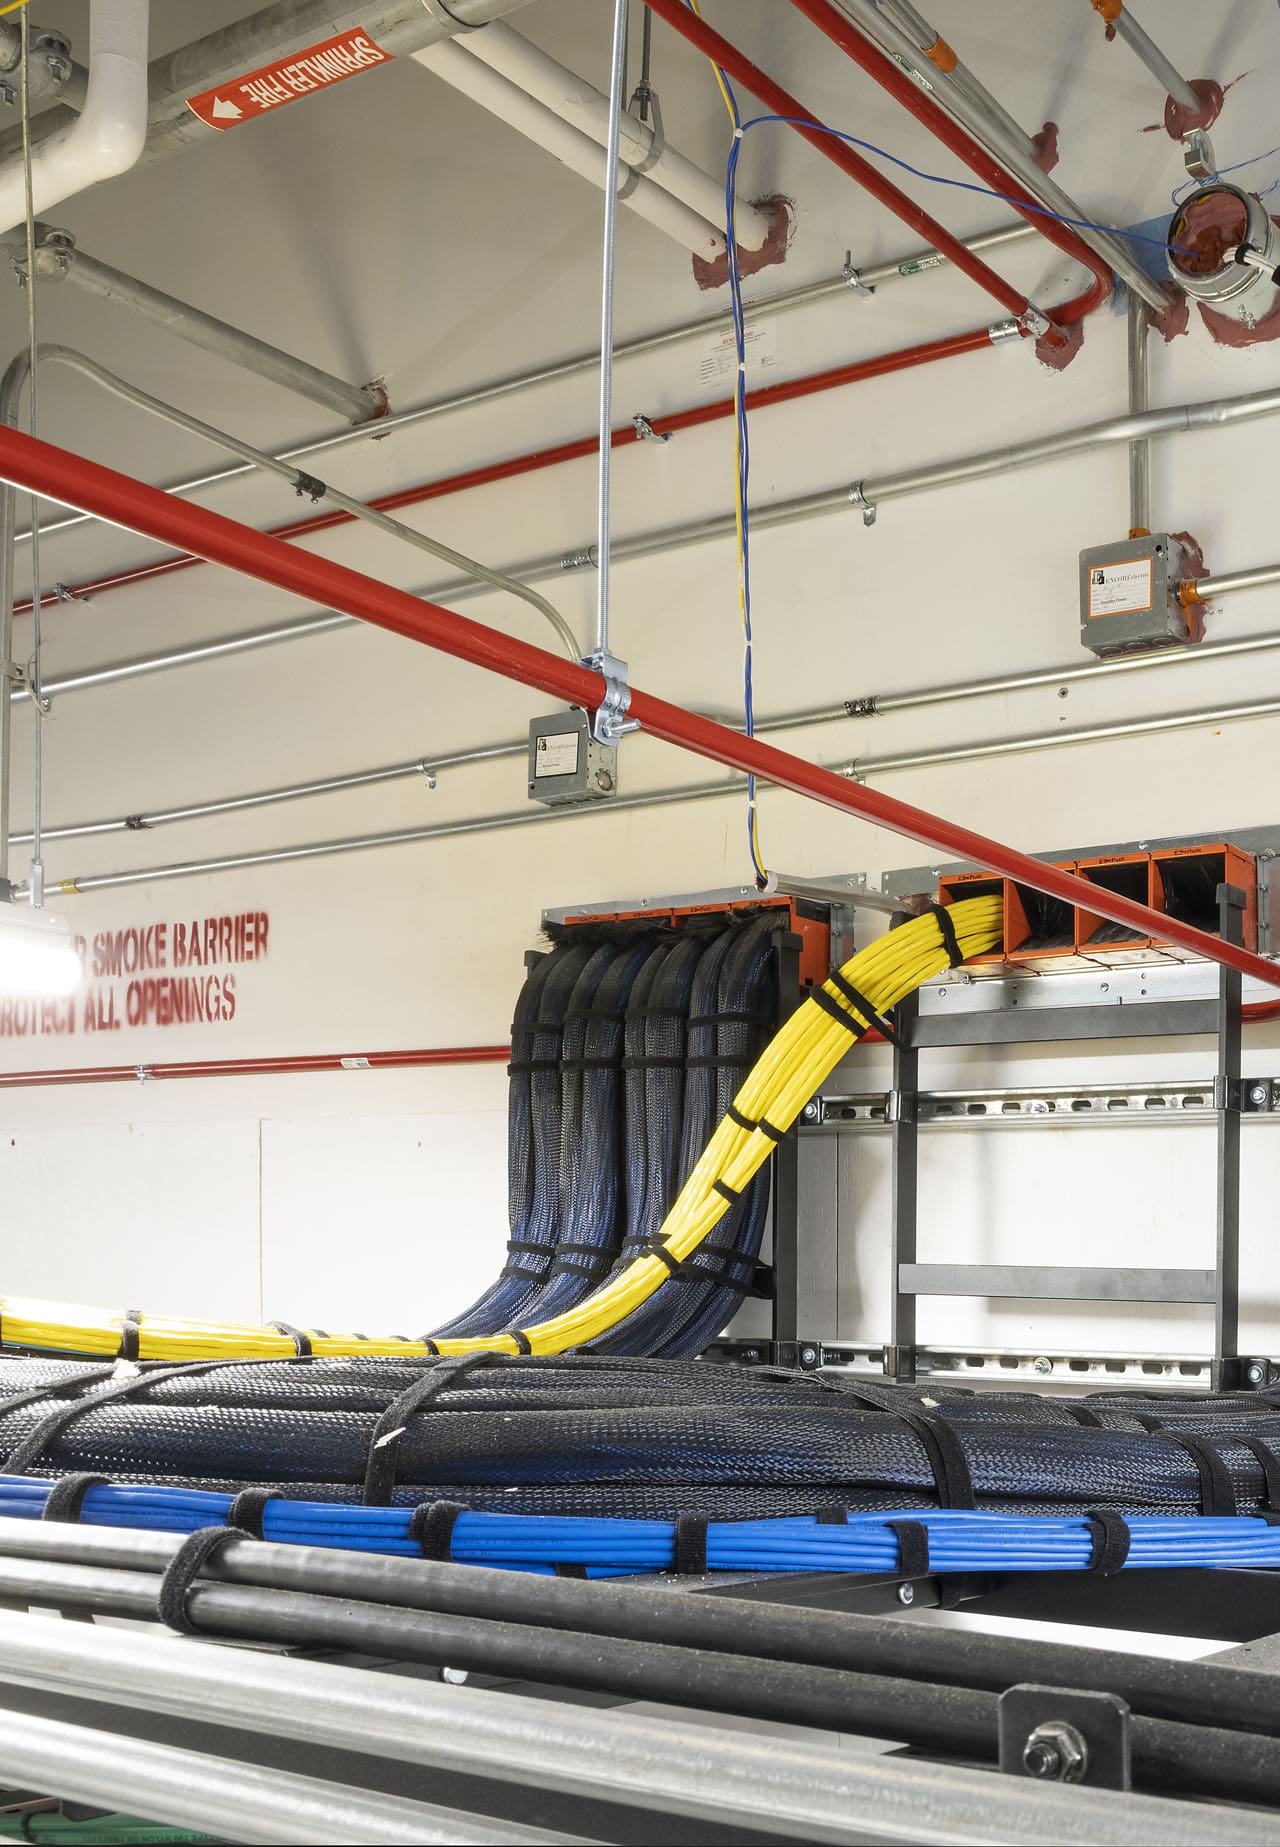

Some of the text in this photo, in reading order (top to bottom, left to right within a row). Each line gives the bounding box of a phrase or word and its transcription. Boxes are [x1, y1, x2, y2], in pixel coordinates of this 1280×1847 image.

[239, 36, 385, 108] SPRINKLER FIRE
[92, 923, 167, 978] SMOKE
[173, 911, 269, 967] BARRIER
[84, 986, 120, 1032] ALL
[126, 973, 237, 1027] OPENINGS
